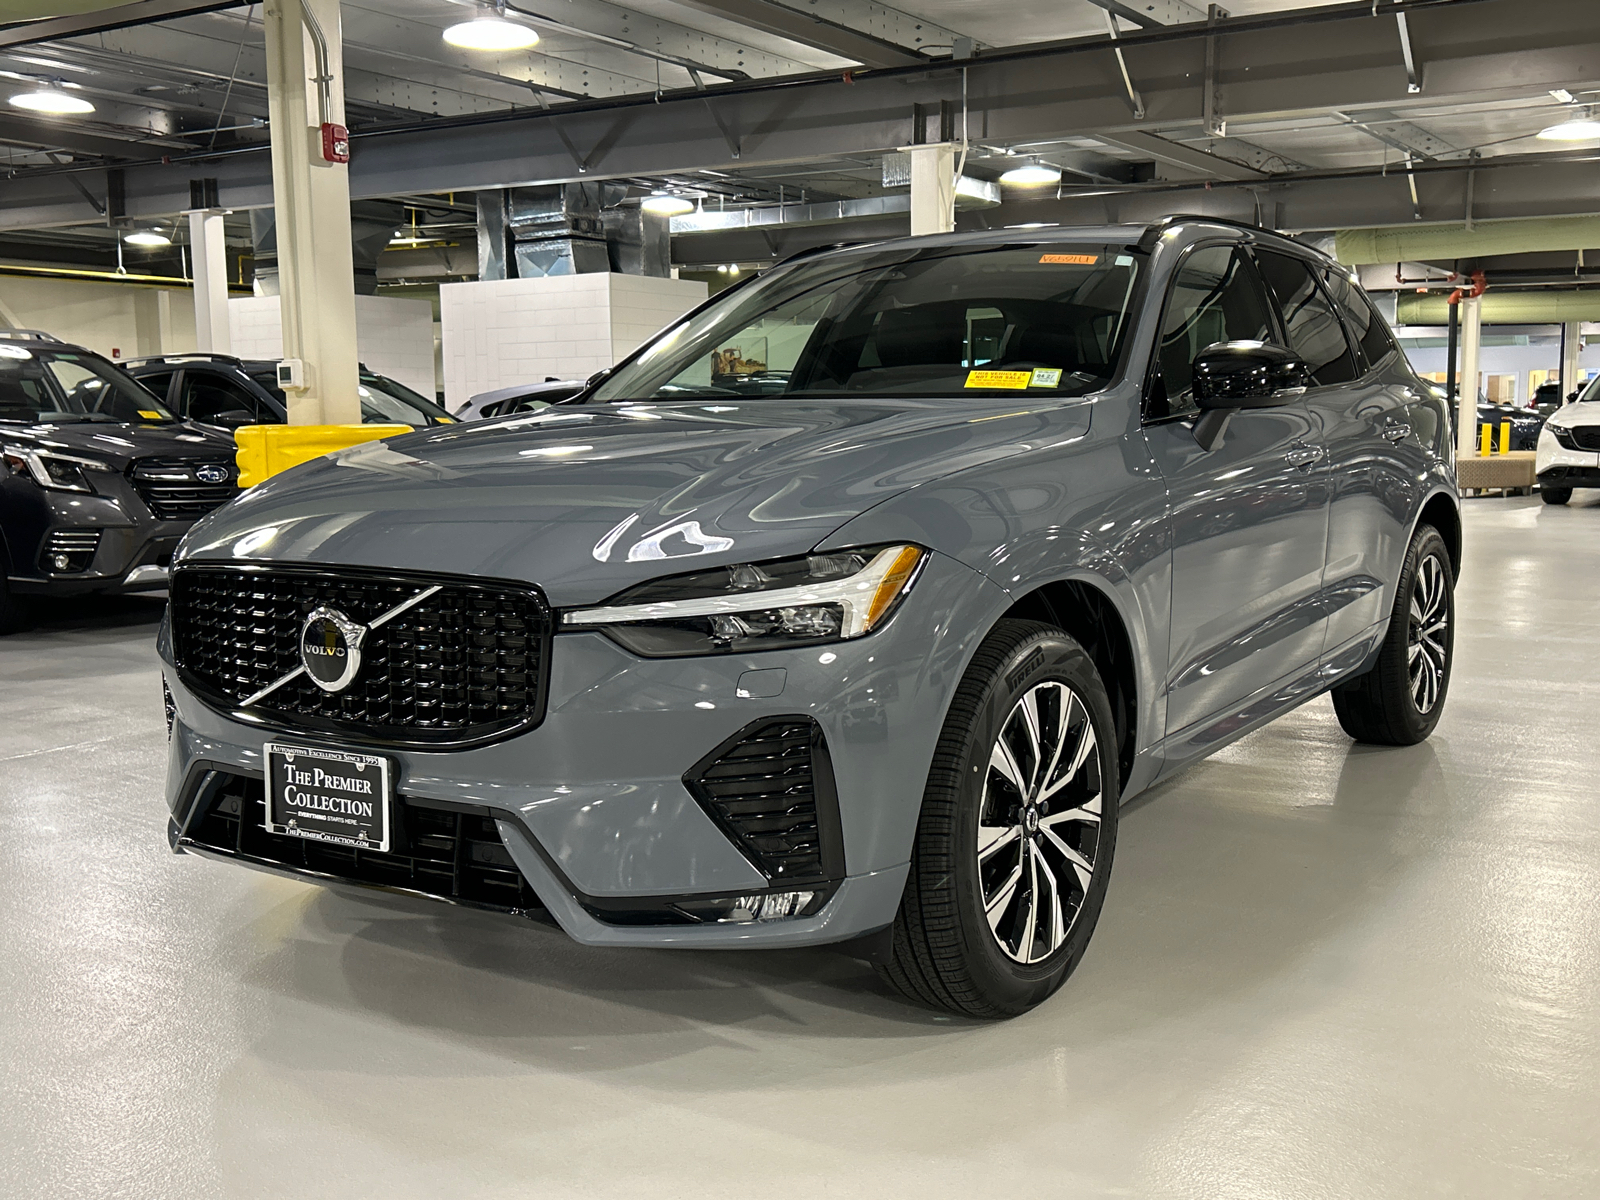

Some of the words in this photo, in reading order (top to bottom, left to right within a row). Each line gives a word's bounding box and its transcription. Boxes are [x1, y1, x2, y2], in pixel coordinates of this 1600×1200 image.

[304, 644, 346, 657] VOLVO
[1004, 645, 1046, 694] PIRELLI
[284, 764, 312, 786] THE
[313, 768, 373, 794] PREMIER
[284, 785, 373, 817] COLLECTION
[298, 811, 327, 821] EVERYTHING
